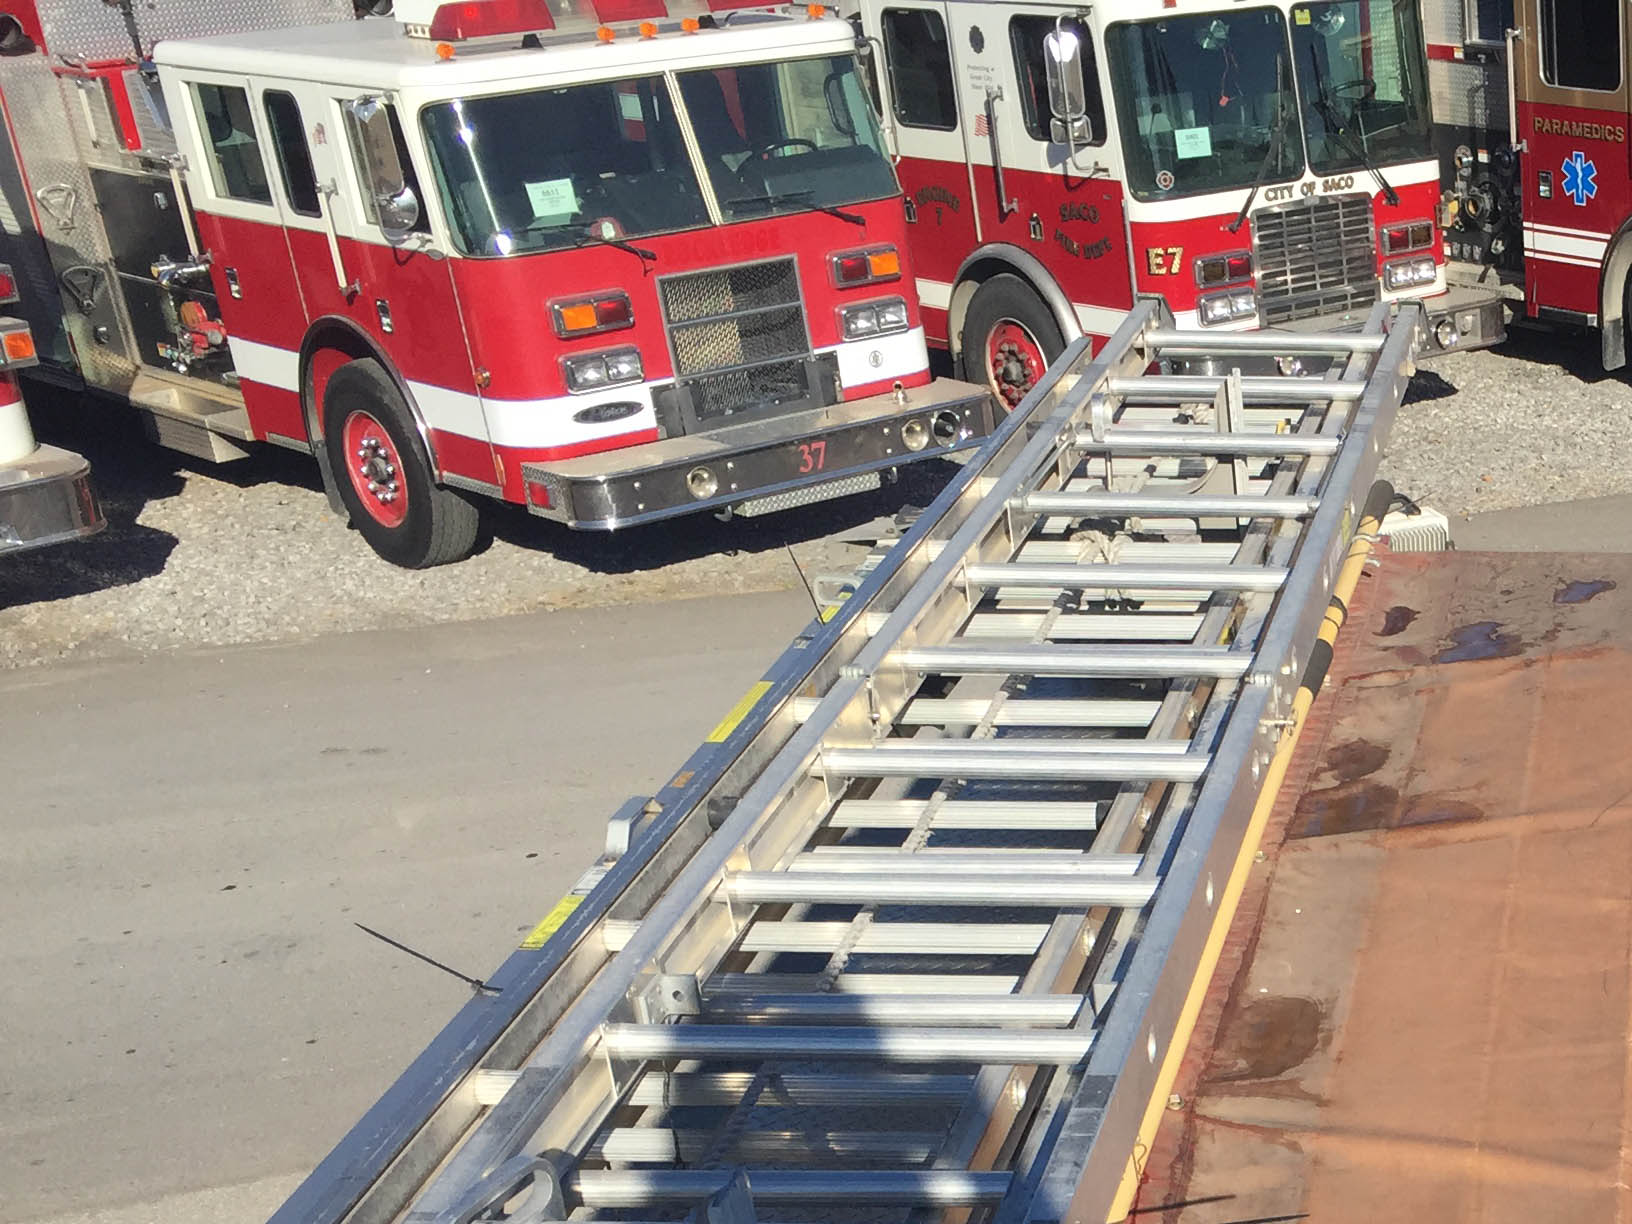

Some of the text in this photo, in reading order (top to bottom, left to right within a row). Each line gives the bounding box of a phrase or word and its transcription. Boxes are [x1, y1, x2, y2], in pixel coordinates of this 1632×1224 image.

[1533, 116, 1625, 143] PARAMEDICS
[1264, 175, 1354, 202] CITY OF SACO
[1059, 202, 1100, 224] SACO
[1146, 246, 1184, 276] E7
[798, 441, 827, 473] 37
